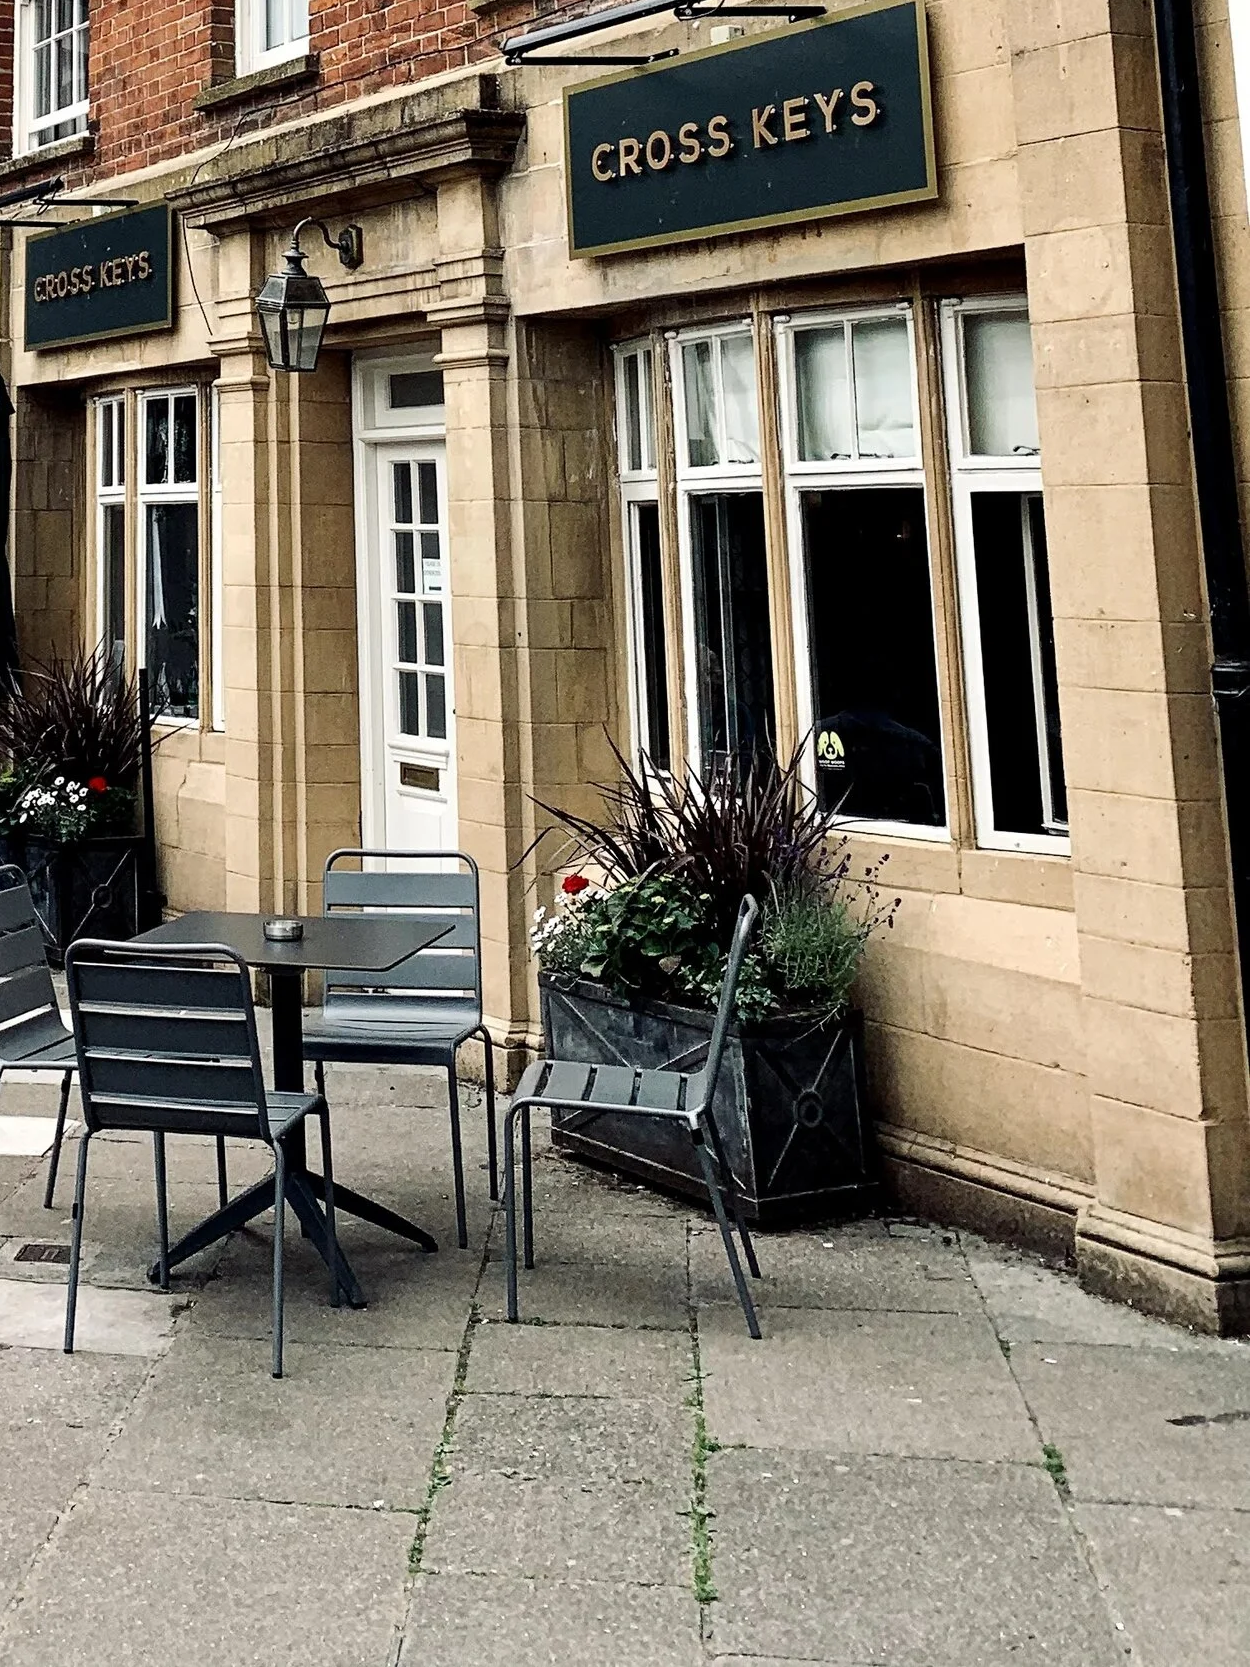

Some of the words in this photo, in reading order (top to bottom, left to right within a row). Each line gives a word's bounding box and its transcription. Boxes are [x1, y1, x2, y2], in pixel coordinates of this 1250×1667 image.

[592, 115, 734, 182] CROSS
[751, 81, 879, 149] KEYS
[34, 265, 95, 302] CROSS
[100, 251, 151, 288] KEYS
